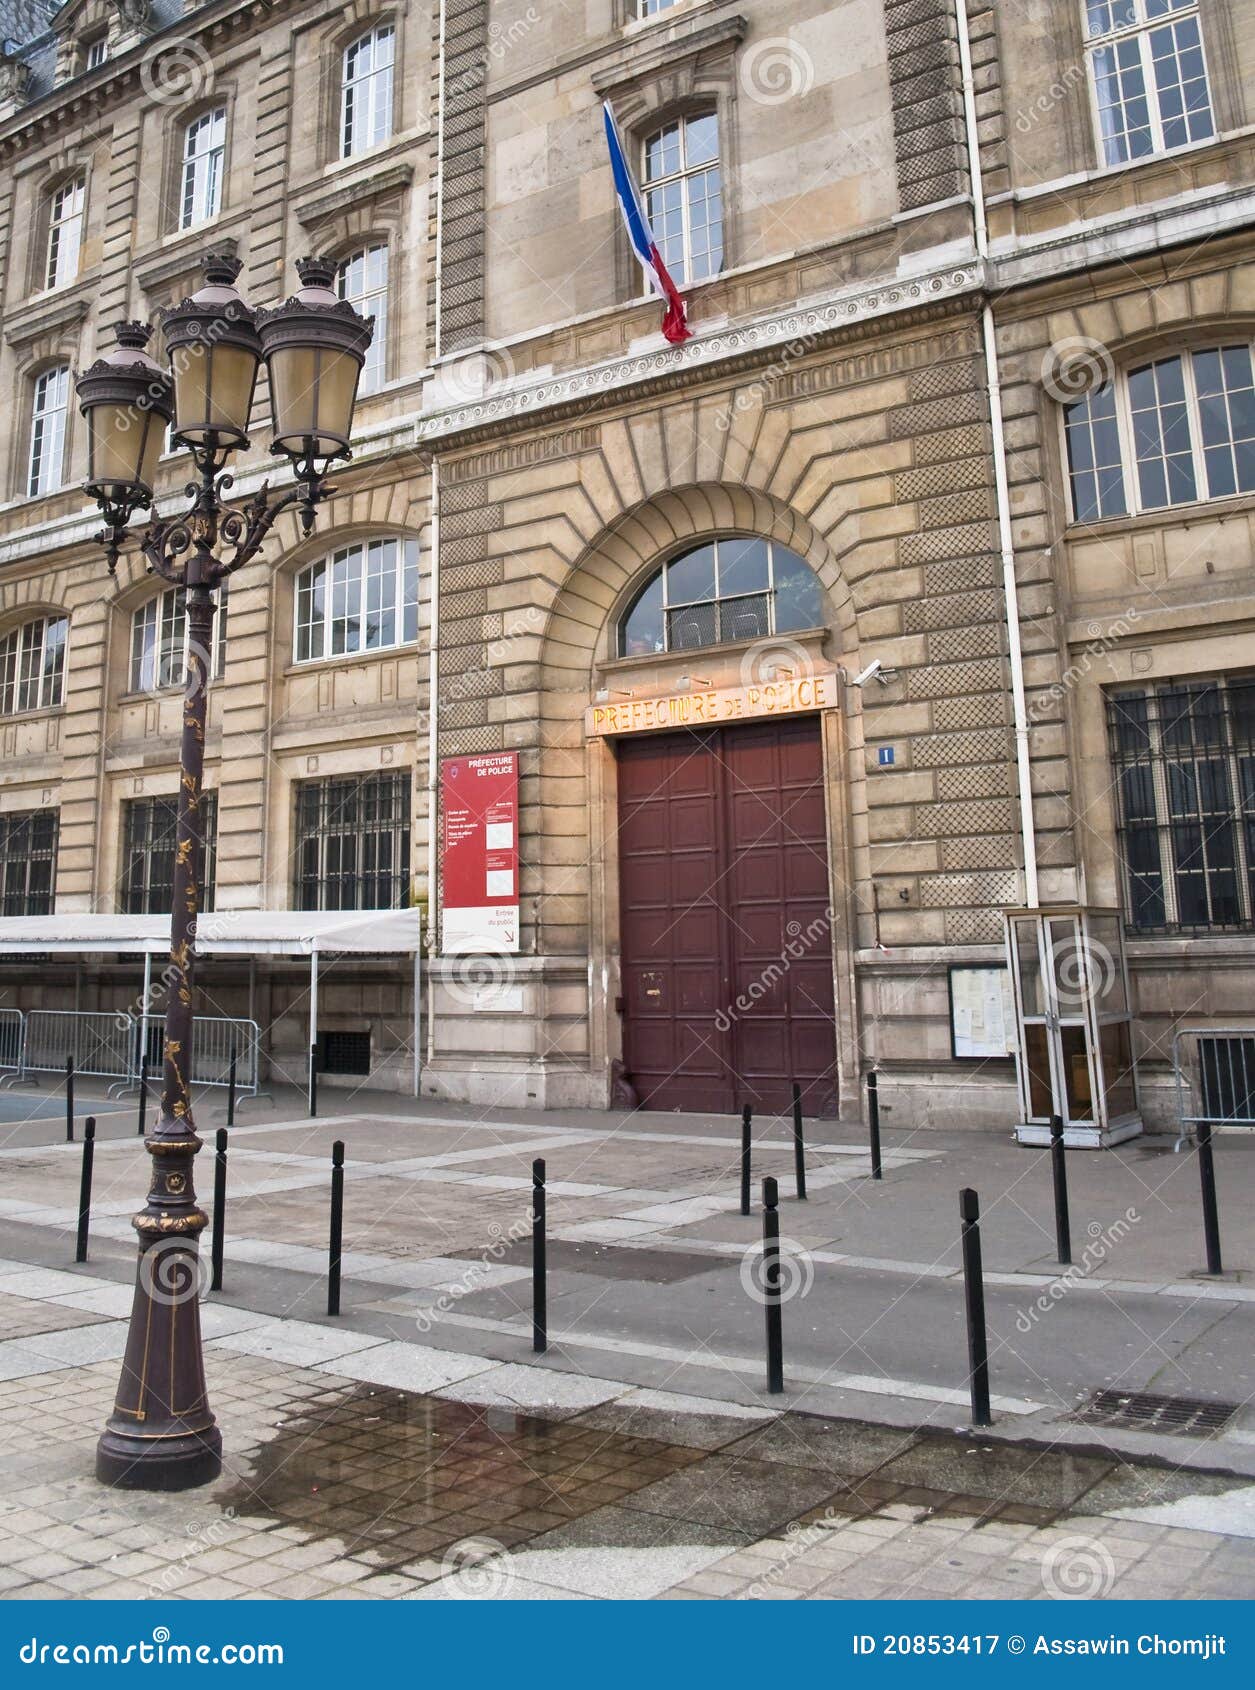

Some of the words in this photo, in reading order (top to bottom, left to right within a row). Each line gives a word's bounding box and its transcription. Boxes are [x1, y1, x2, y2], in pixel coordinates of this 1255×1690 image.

[748, 679, 826, 713] POLICE
[468, 756, 513, 768] PRÉFECTURE
[477, 768, 487, 777] DE
[488, 765, 513, 776] POLICE
